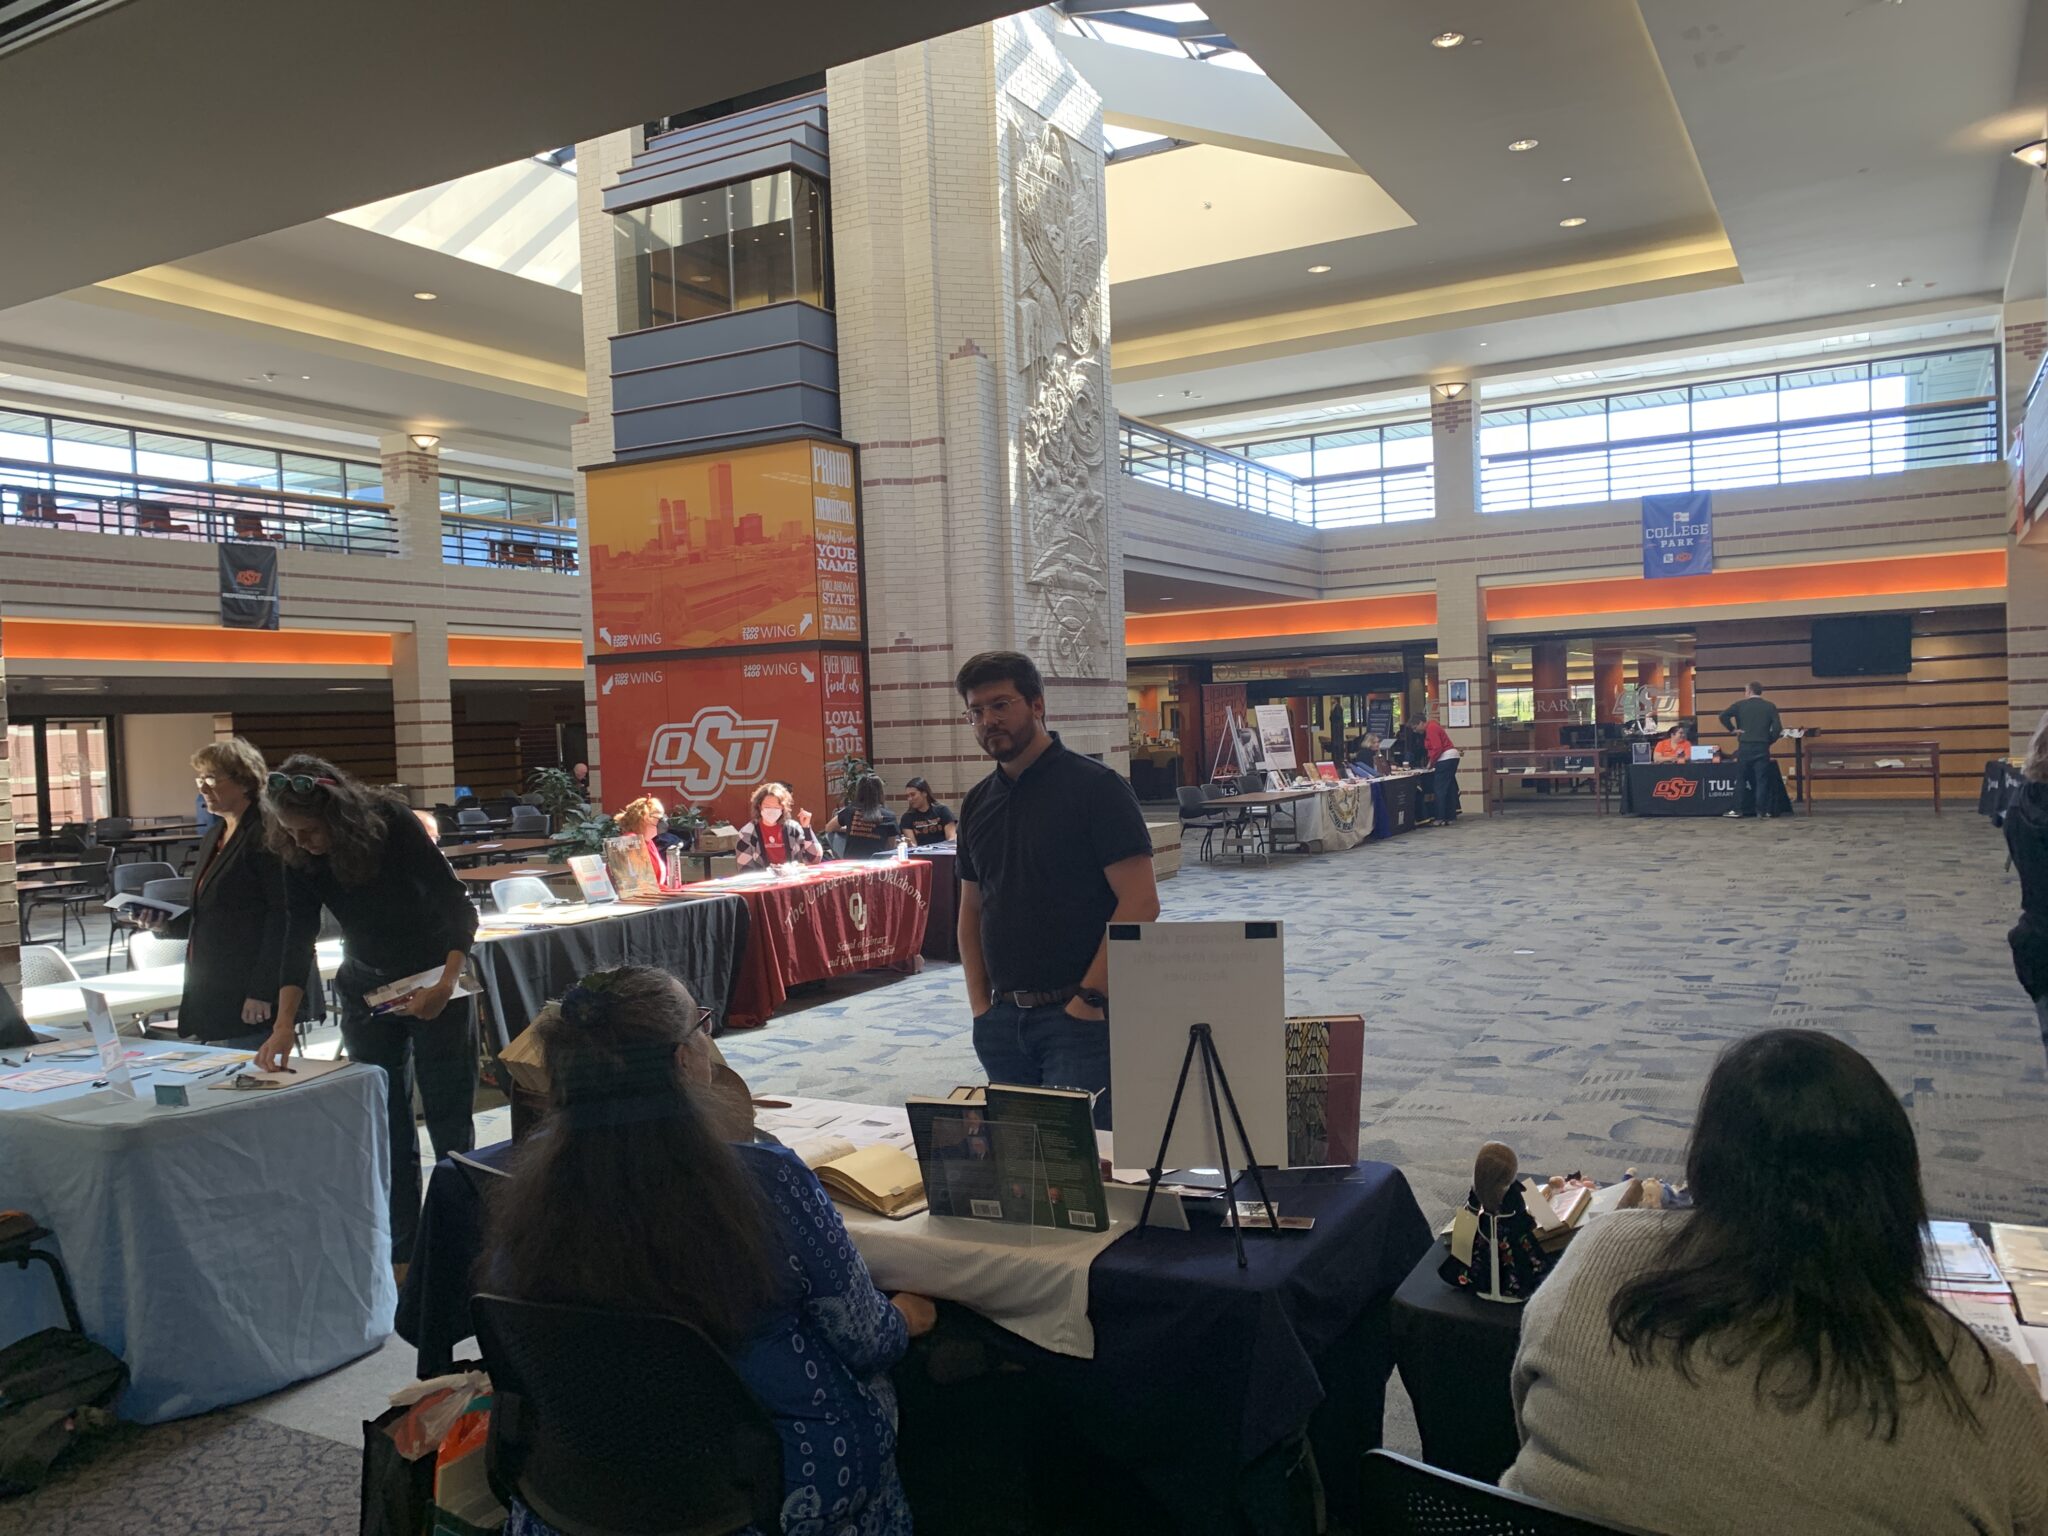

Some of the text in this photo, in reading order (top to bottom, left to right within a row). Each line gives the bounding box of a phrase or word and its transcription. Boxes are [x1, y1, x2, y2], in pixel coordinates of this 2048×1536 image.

[813, 447, 852, 489] PROUD
[1646, 524, 1709, 539] COLLEGE
[1661, 538, 1694, 548] PARK
[816, 544, 856, 560] YOUR
[817, 559, 857, 573] NAME
[822, 593, 856, 606] STATE
[760, 624, 797, 638] WING
[823, 614, 857, 632] FAME
[628, 632, 662, 645] WING
[761, 662, 798, 676] WING
[824, 655, 839, 674] EVER
[629, 670, 663, 684] WING
[744, 670, 761, 678] 1400
[825, 674, 847, 699] find
[825, 710, 863, 726] LOYAL
[826, 737, 863, 754] TRUE
[646, 711, 774, 797] OSU
[1653, 777, 1698, 801] OSU
[785, 901, 806, 933] The
[877, 869, 928, 910] Oklahoma
